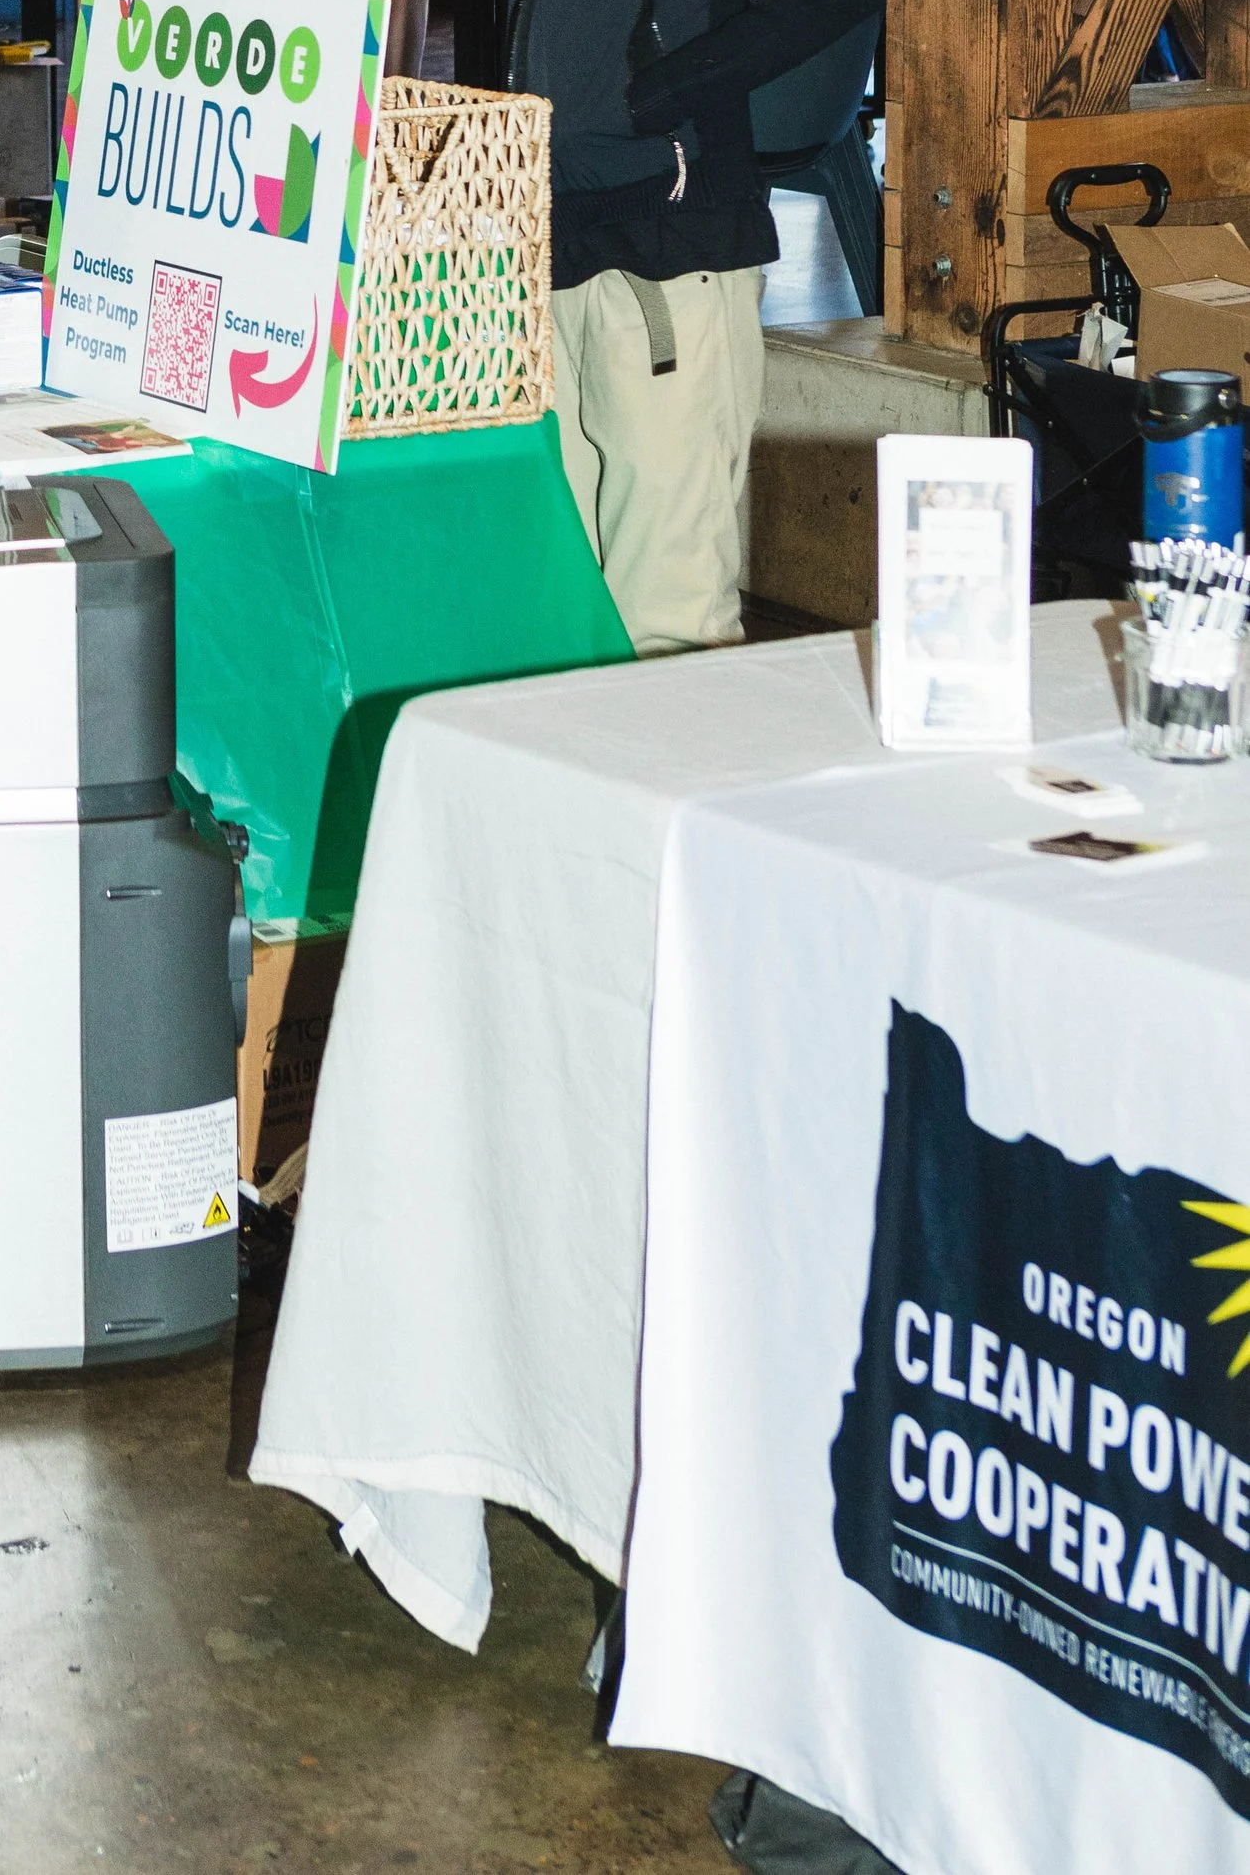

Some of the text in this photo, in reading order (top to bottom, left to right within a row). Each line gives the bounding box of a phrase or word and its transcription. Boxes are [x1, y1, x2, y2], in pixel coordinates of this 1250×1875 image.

[123, 12, 308, 87] VERDE
[97, 81, 252, 228] BUILDS
[59, 285, 139, 330] Heat Pump
[73, 250, 134, 285] Ductless
[65, 326, 127, 366] Program
[224, 310, 305, 349] Scan Here!
[1021, 1261, 1187, 1377] OREGON
[893, 1299, 1250, 1551] CLEAN POWE
[889, 1412, 1250, 1678] COOPERATIV
[891, 1543, 1081, 1667] COMMUNITY-OWNED
[1084, 1640, 1209, 1732] RENEWABLE
